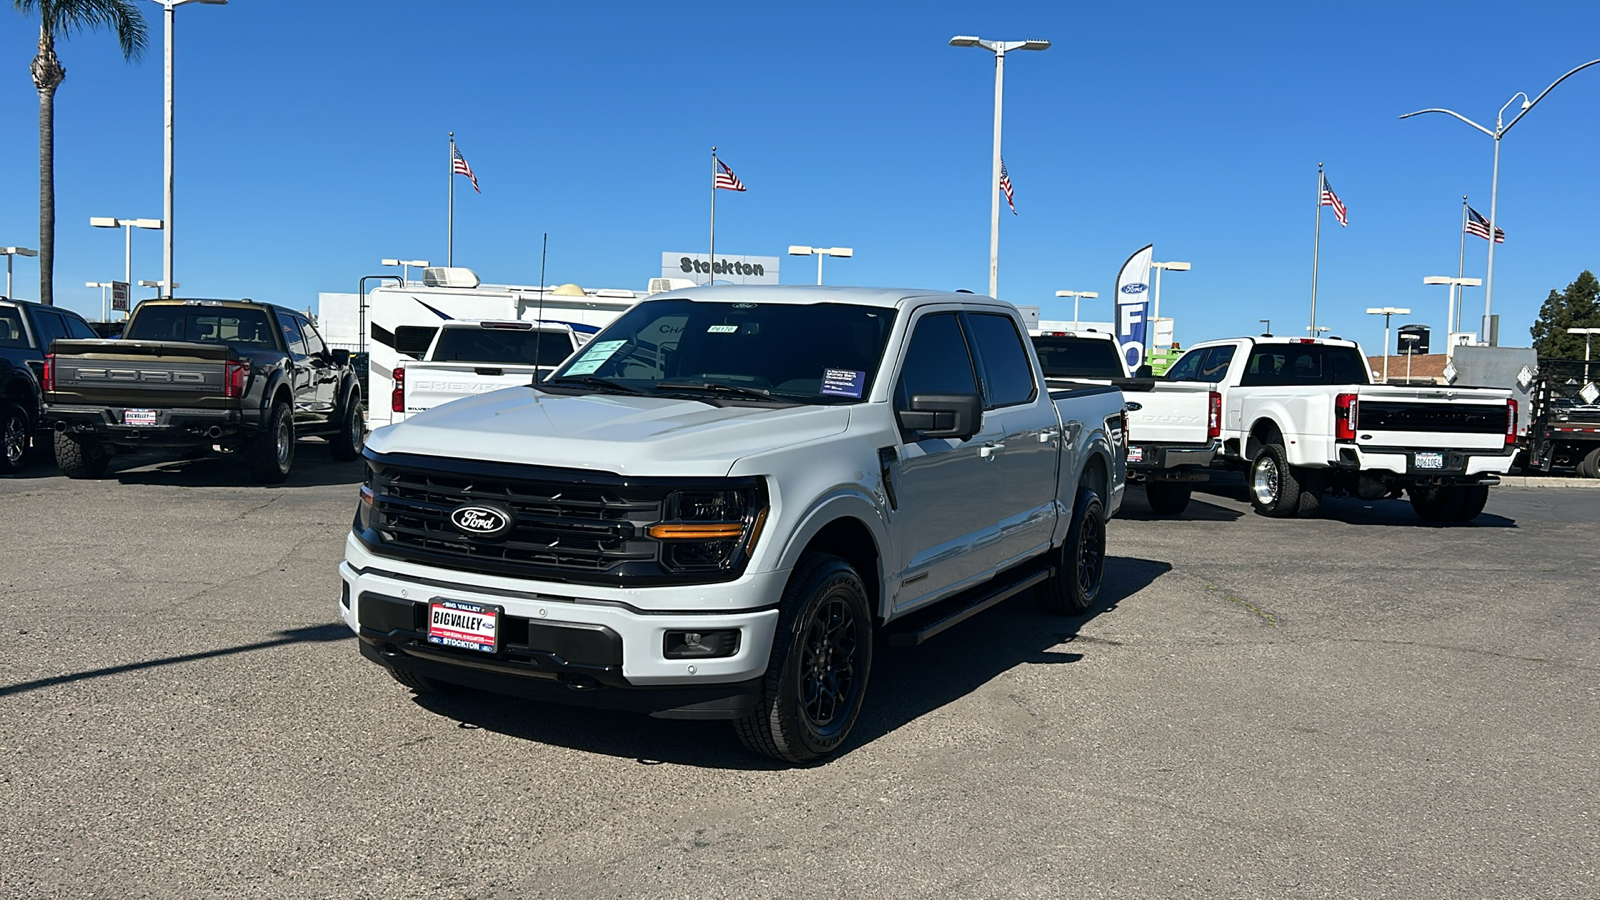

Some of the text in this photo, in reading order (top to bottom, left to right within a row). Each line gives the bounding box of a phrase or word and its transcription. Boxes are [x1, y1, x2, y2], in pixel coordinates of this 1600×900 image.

[680, 257, 764, 276] Stockton
[1125, 284, 1144, 294] Ford
[113, 299, 126, 309] CARS
[75, 368, 207, 383] FORD
[415, 381, 513, 391] CHEVR
[1142, 414, 1200, 424] DUTY
[461, 510, 495, 529] Ford
[457, 603, 481, 612] VALLEY
[433, 611, 483, 631] BIGVALLEY
[443, 637, 480, 650] STOCKTON
